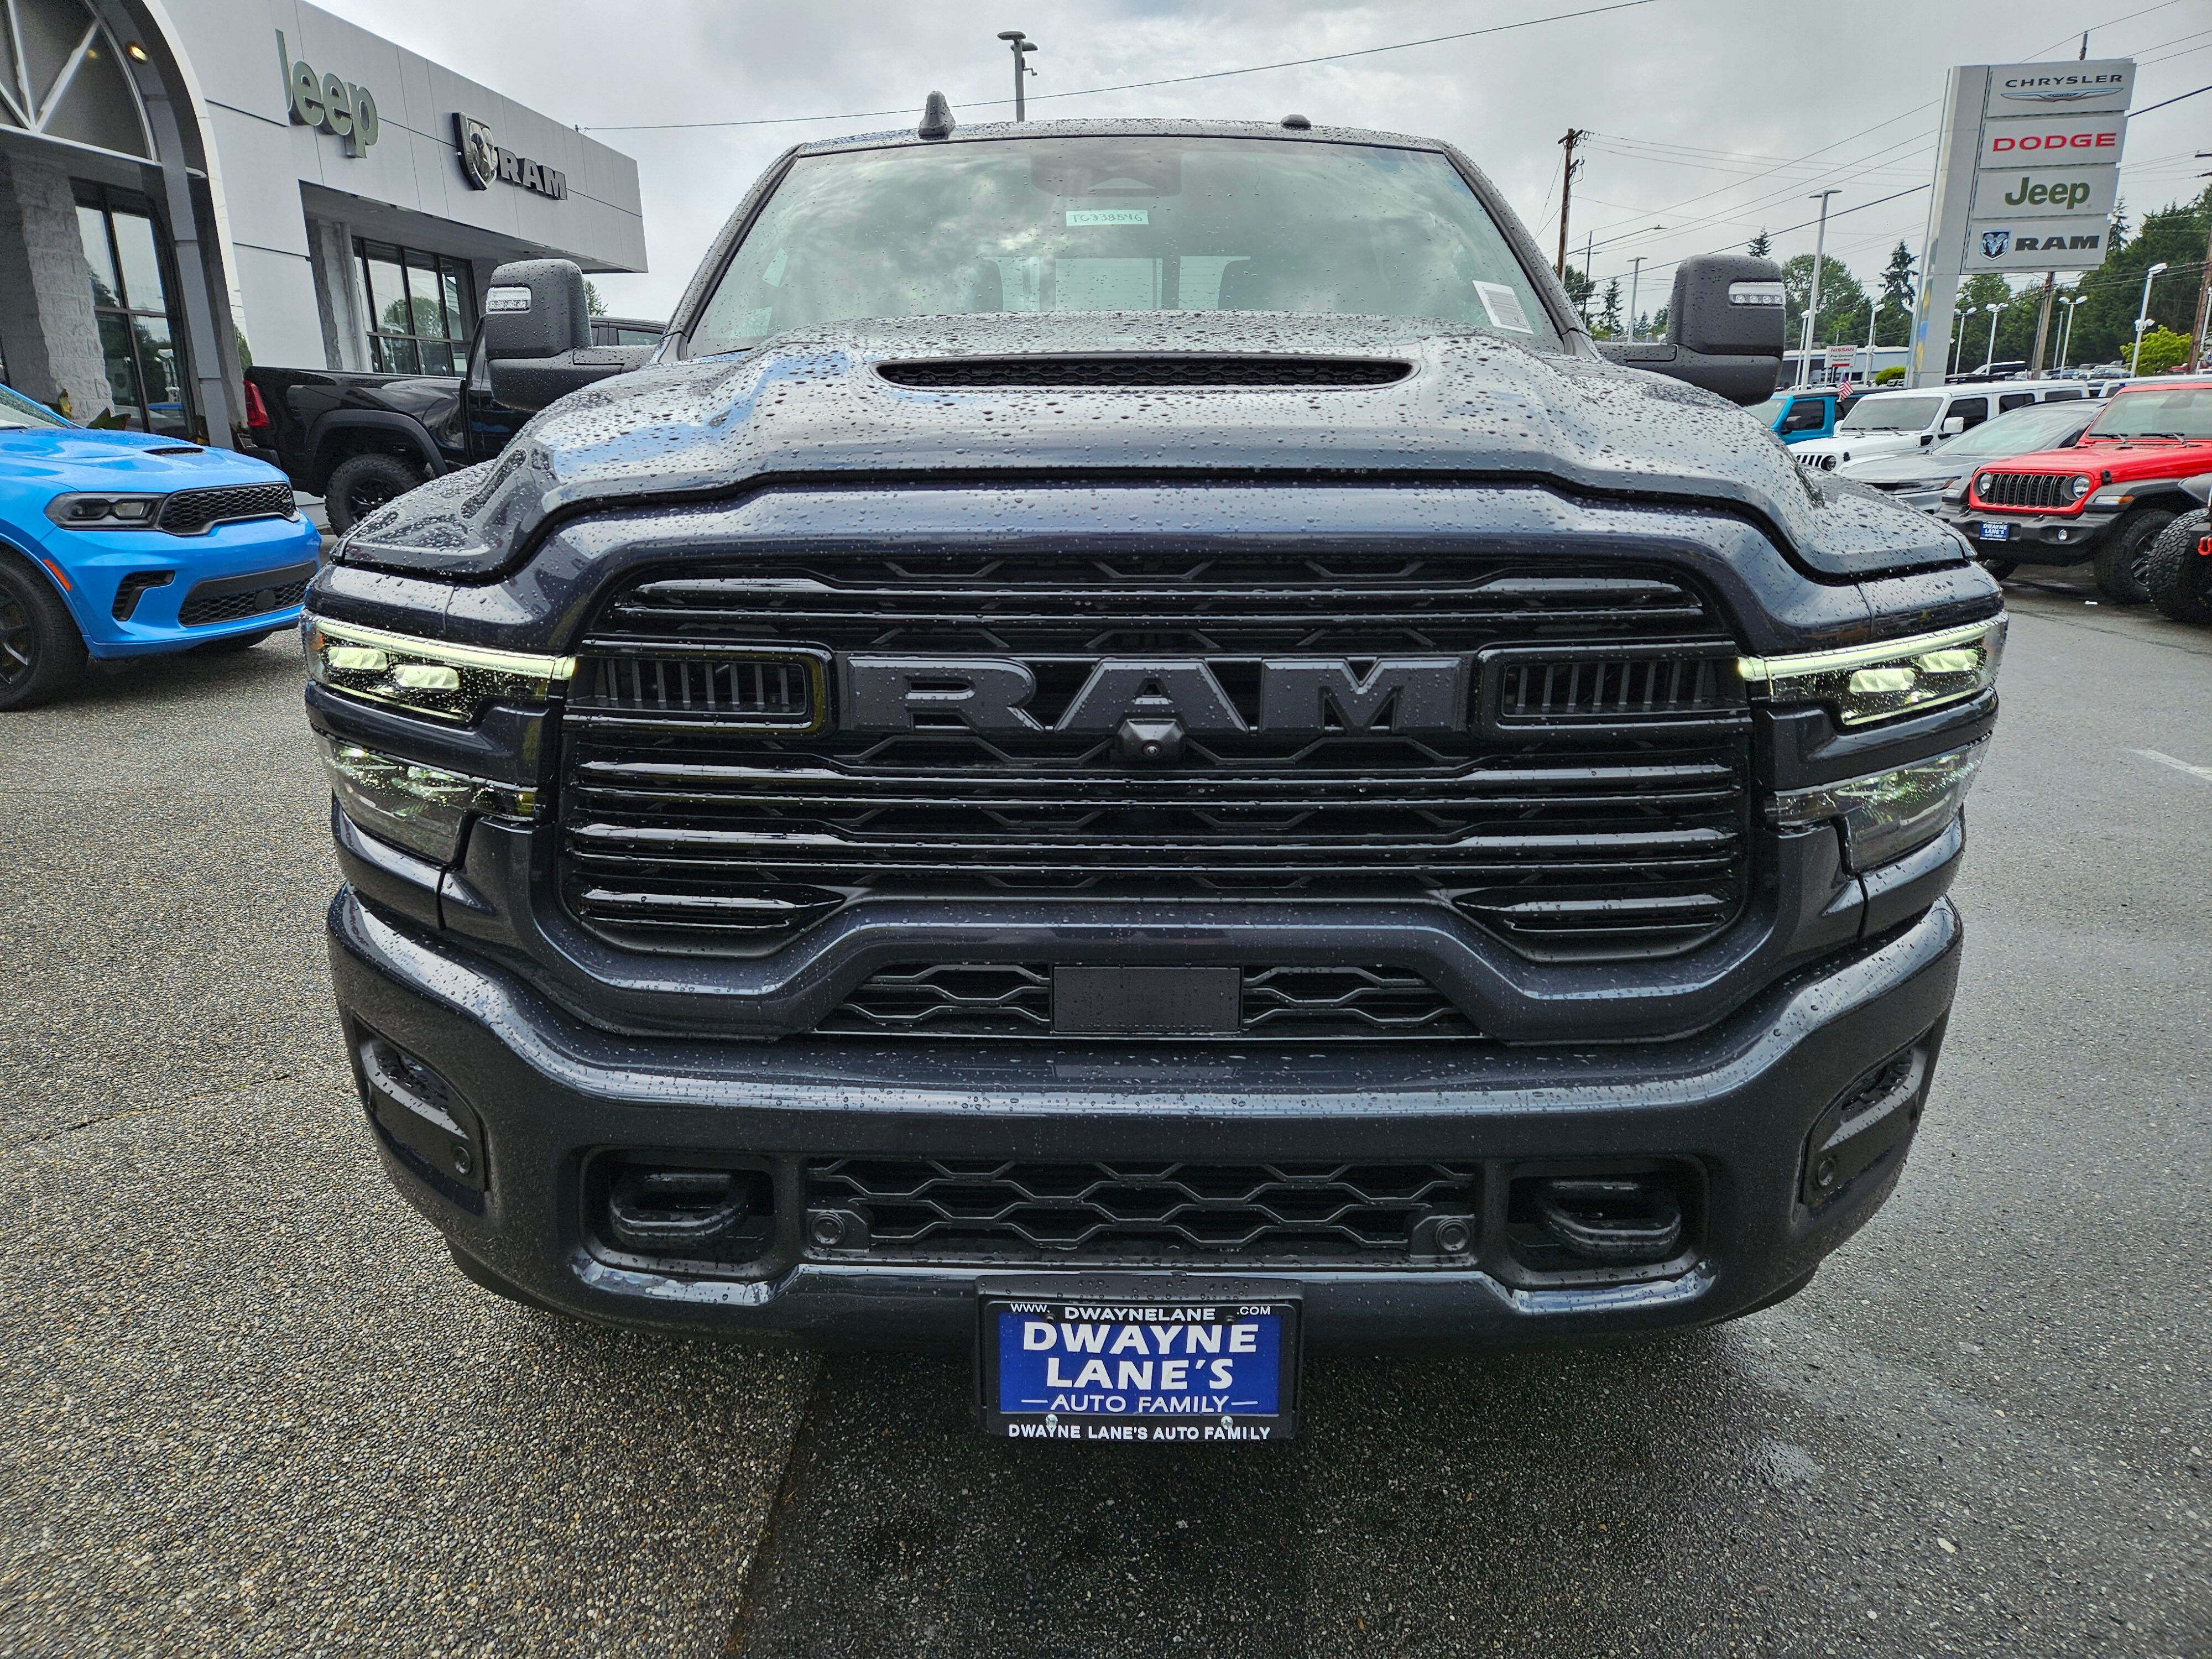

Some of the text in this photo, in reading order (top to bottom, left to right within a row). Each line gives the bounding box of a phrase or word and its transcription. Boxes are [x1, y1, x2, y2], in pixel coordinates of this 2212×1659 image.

[2005, 74, 2123, 87] CHRYSLER
[1993, 133, 2116, 152] DODGE
[497, 146, 568, 201] RAM
[2005, 177, 2090, 210] Jeep
[2015, 235, 2100, 251] RAM
[848, 656, 1464, 734] RAM
[1065, 1306, 1215, 1321] DWAYNELANE
[1023, 1321, 1259, 1355] DWAYNE
[1046, 1358, 1233, 1390] LANE'S
[1050, 1394, 1229, 1413] AUTO FAMILY
[1009, 1423, 1270, 1441] DWAYNE LANE'S AUTO FAMILY
